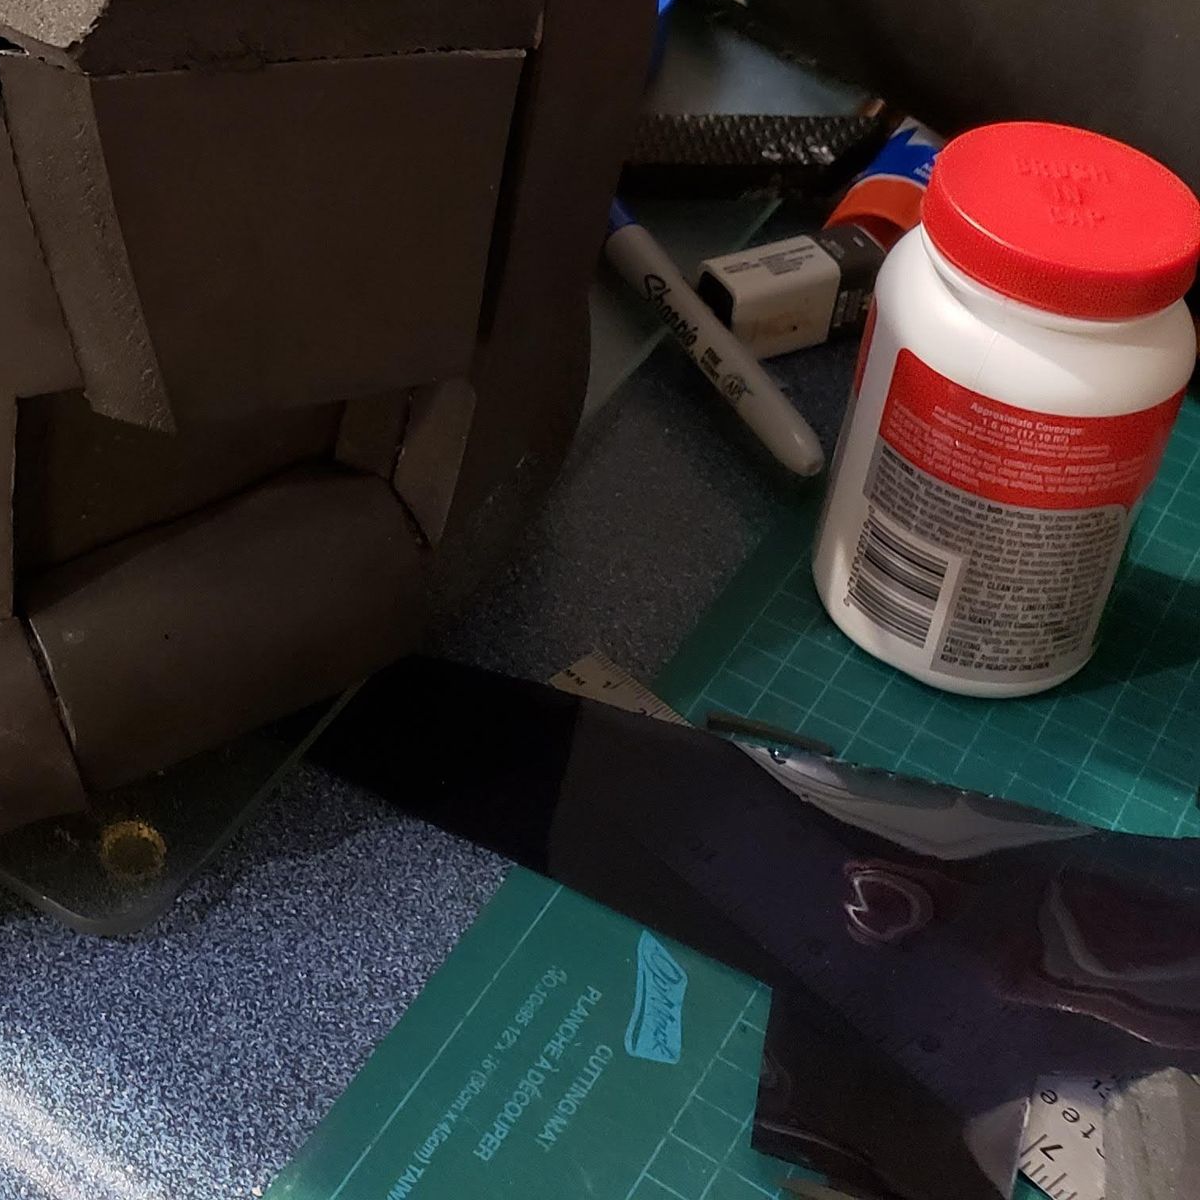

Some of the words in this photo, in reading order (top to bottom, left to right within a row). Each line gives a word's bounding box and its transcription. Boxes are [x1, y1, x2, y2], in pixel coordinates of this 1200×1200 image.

[970, 402, 1033, 429] Approximate
[1035, 422, 1085, 436] Coverage
[968, 614, 993, 625] HEAVY
[940, 653, 959, 665] KEEP
[959, 658, 974, 668] OUT
[974, 661, 984, 669] OF
[985, 662, 1008, 671] REACH
[1008, 662, 1018, 672] OF
[1018, 661, 1050, 672] CHILDREN
[543, 984, 603, 1063] PLANCHE
[534, 1058, 560, 1080] À
[557, 1043, 615, 1118] CUTTING
[472, 1072, 546, 1162] DÉCOUPER
[534, 1113, 568, 1152] MAT
[412, 1121, 453, 1165] 45cm)
[1039, 1143, 1064, 1162] 7
